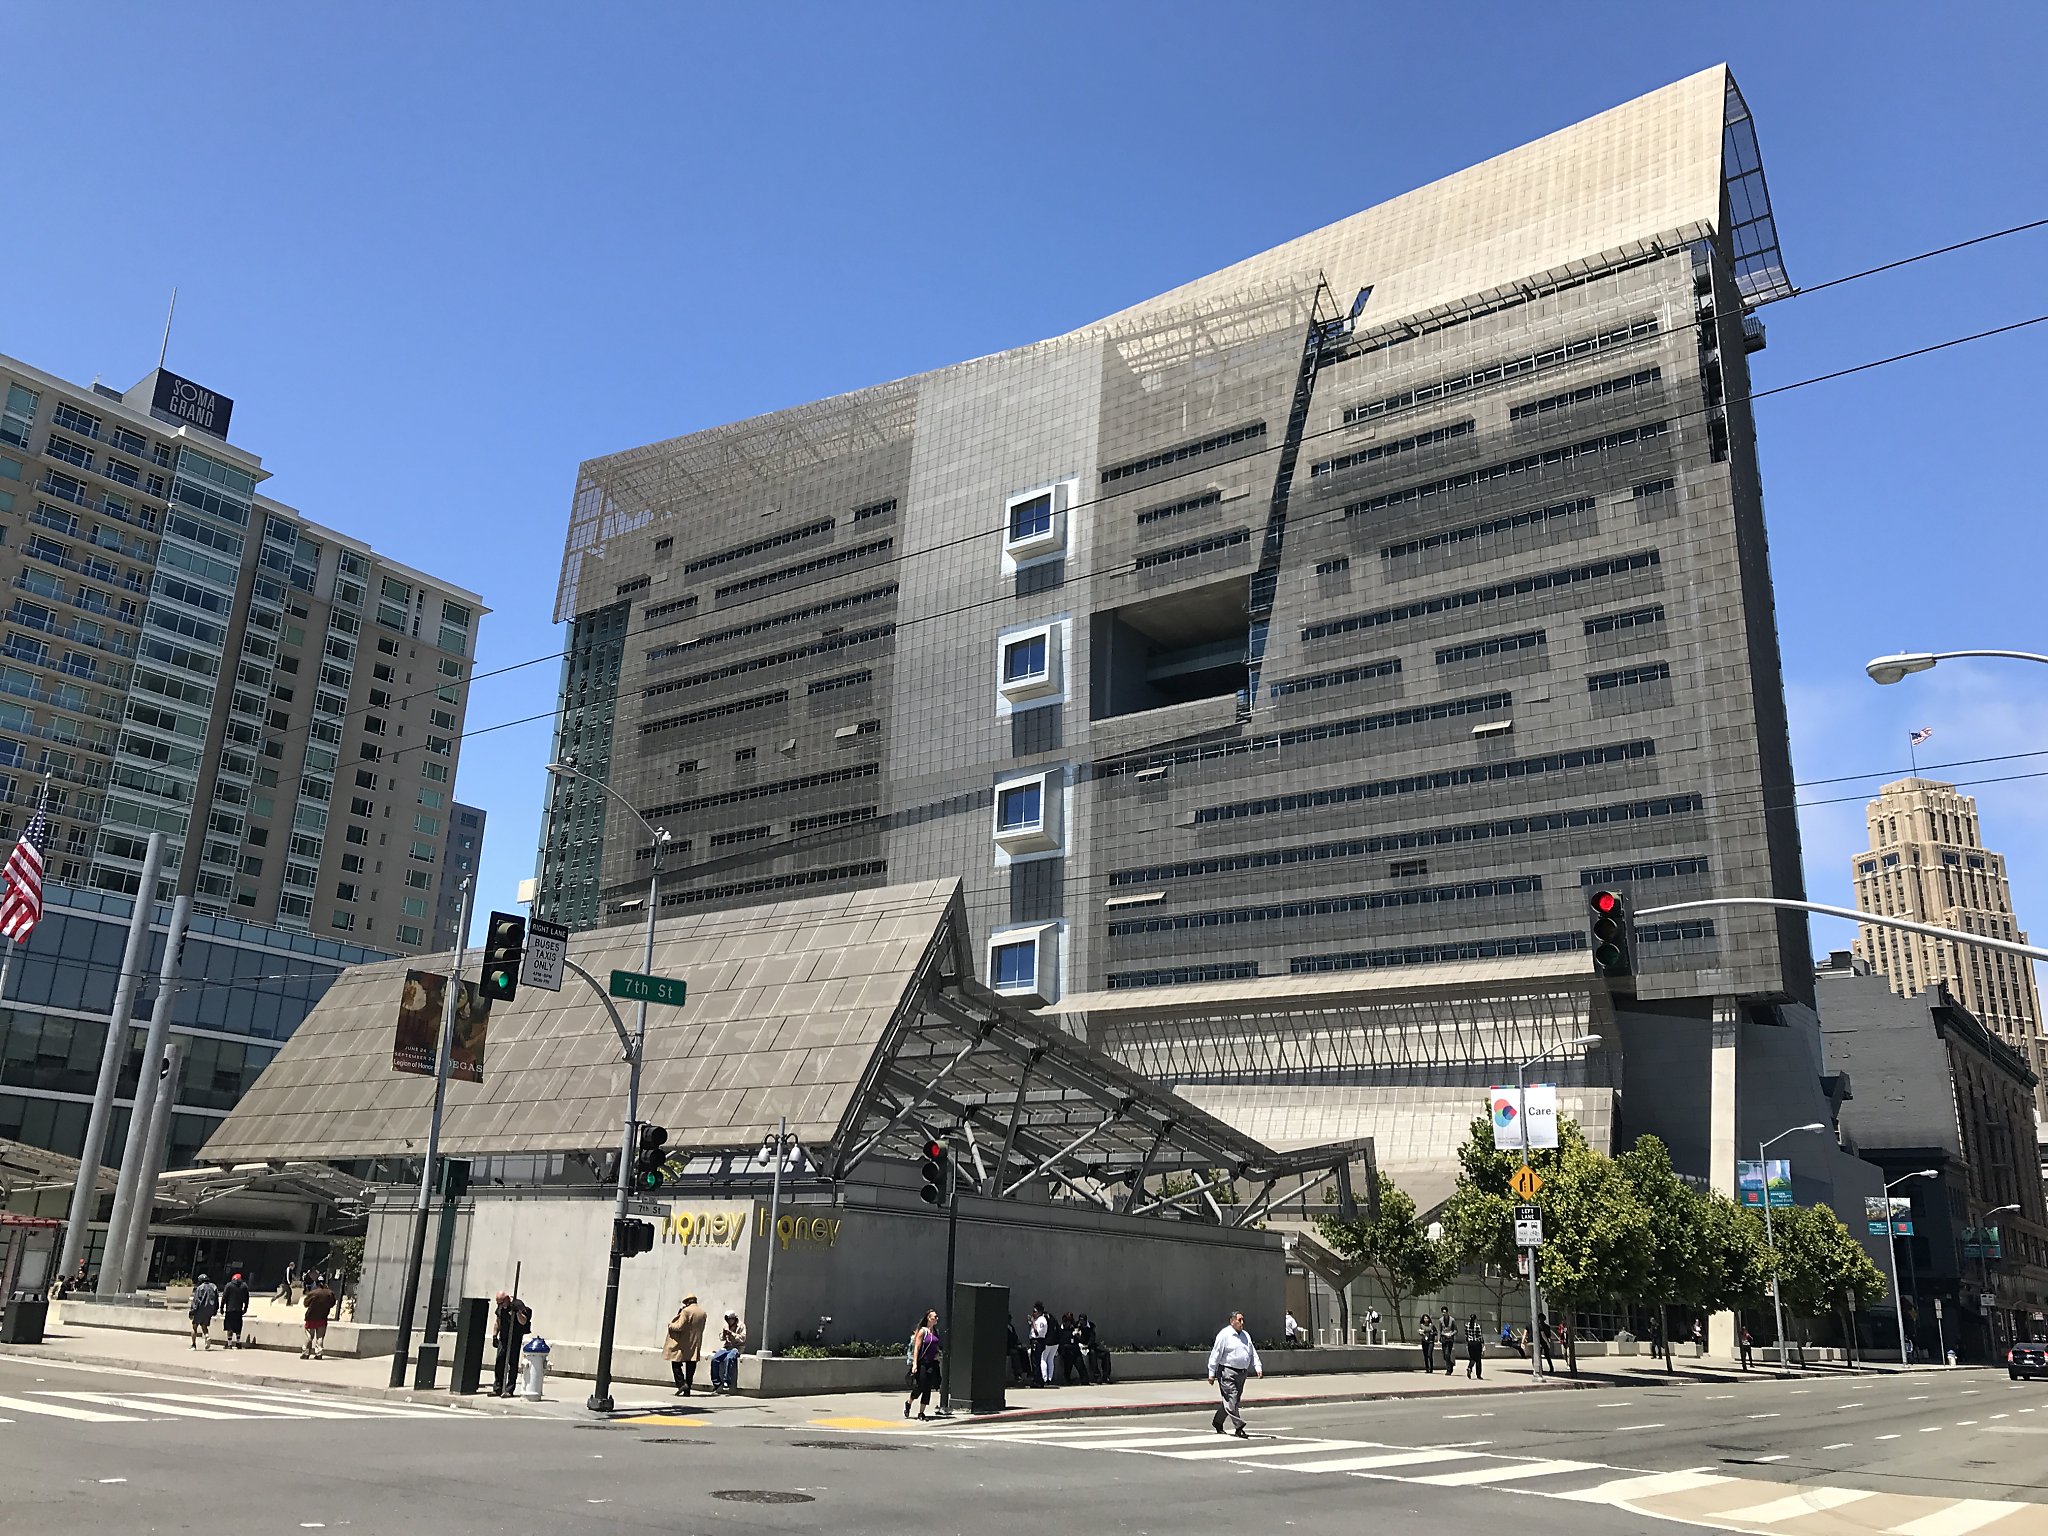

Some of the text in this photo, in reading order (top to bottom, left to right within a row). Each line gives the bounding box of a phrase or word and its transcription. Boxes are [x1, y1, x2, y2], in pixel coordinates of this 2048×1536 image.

[173, 380, 215, 411] SOMA
[170, 396, 213, 427] GRAND
[532, 923, 566, 938] RIGHT LANE
[535, 938, 560, 952] BUSES
[535, 949, 557, 962] TAXIS
[533, 959, 554, 972] ONLY
[624, 978, 673, 999] 7th St
[394, 1051, 427, 1061] SEPTEMBER
[393, 1058, 411, 1068] Legion
[417, 1062, 434, 1071] Honor
[652, 1206, 661, 1215] St
[662, 1208, 745, 1246] honey
